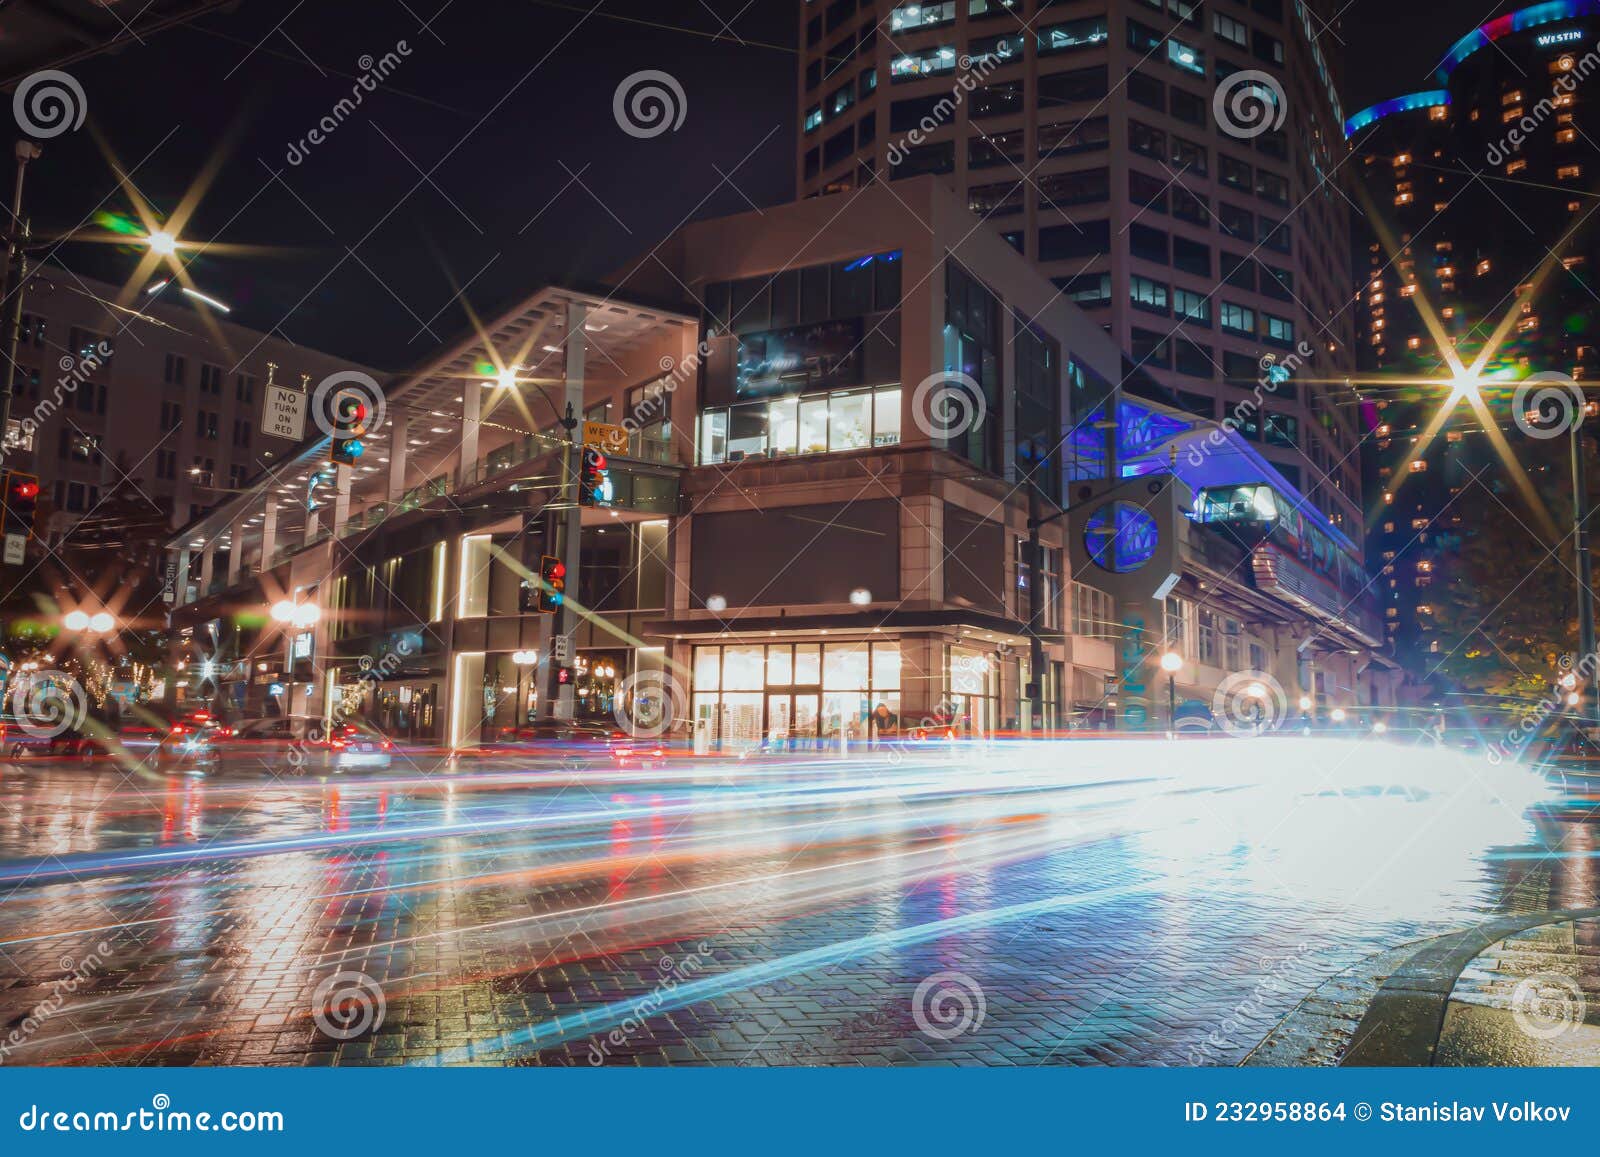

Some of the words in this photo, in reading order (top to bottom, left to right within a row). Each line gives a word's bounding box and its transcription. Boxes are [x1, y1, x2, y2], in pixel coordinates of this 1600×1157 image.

[1538, 31, 1582, 46] WESTIN
[278, 391, 296, 404] NO
[274, 402, 298, 415] TURN
[278, 414, 291, 424] ON
[274, 423, 292, 435] RED
